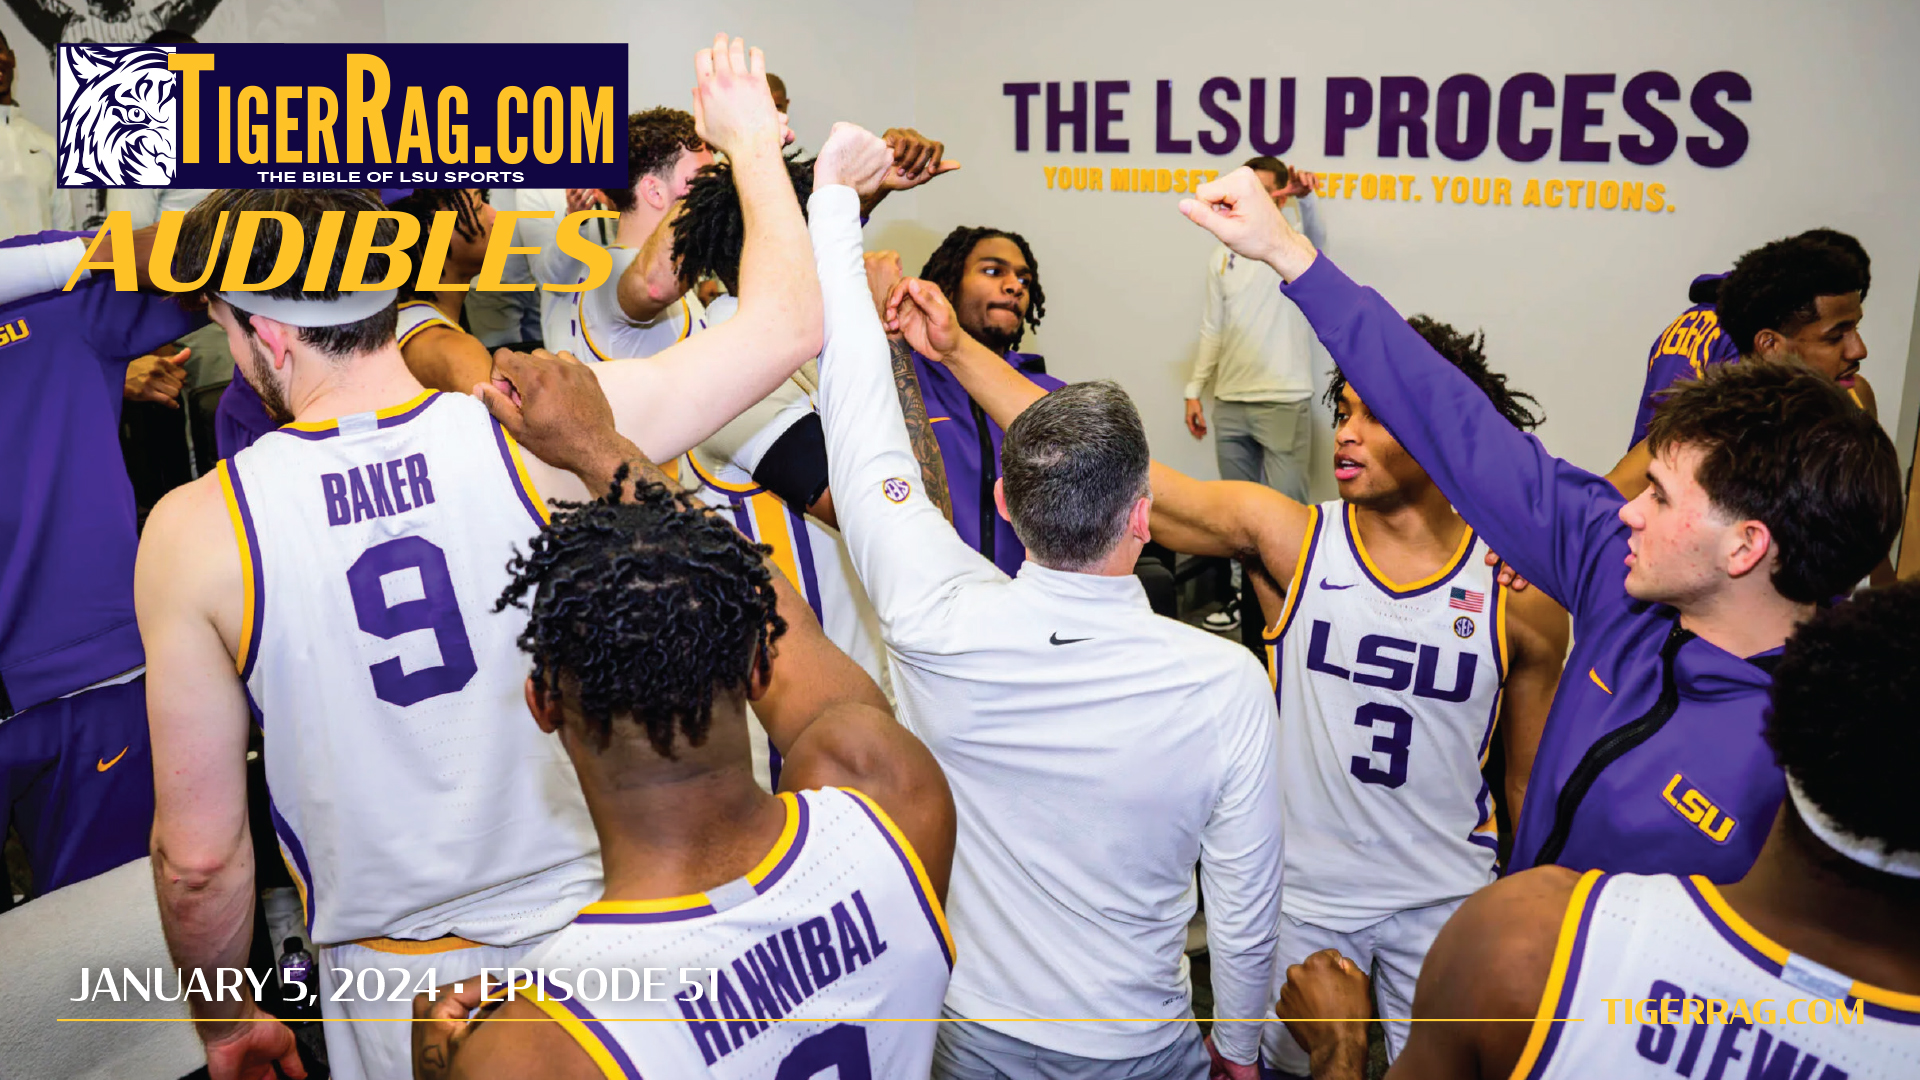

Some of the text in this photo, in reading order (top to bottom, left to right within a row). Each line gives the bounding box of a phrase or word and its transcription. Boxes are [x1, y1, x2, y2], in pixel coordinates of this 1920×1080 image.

[1003, 71, 1752, 168] THE LSU PROCESS
[1044, 166, 1103, 191] YOUR
[1314, 173, 1675, 212] EFFORT. YOUR ACTIONS.
[321, 452, 435, 526] BAKER
[346, 535, 478, 707] 9
[1307, 619, 1478, 703] LSU
[1454, 617, 1474, 638] SEC
[1351, 702, 1413, 789] 3
[1662, 773, 1735, 842] LSU
[674, 889, 887, 1066] HANNIBAL
[1636, 979, 1848, 1080] STEW
